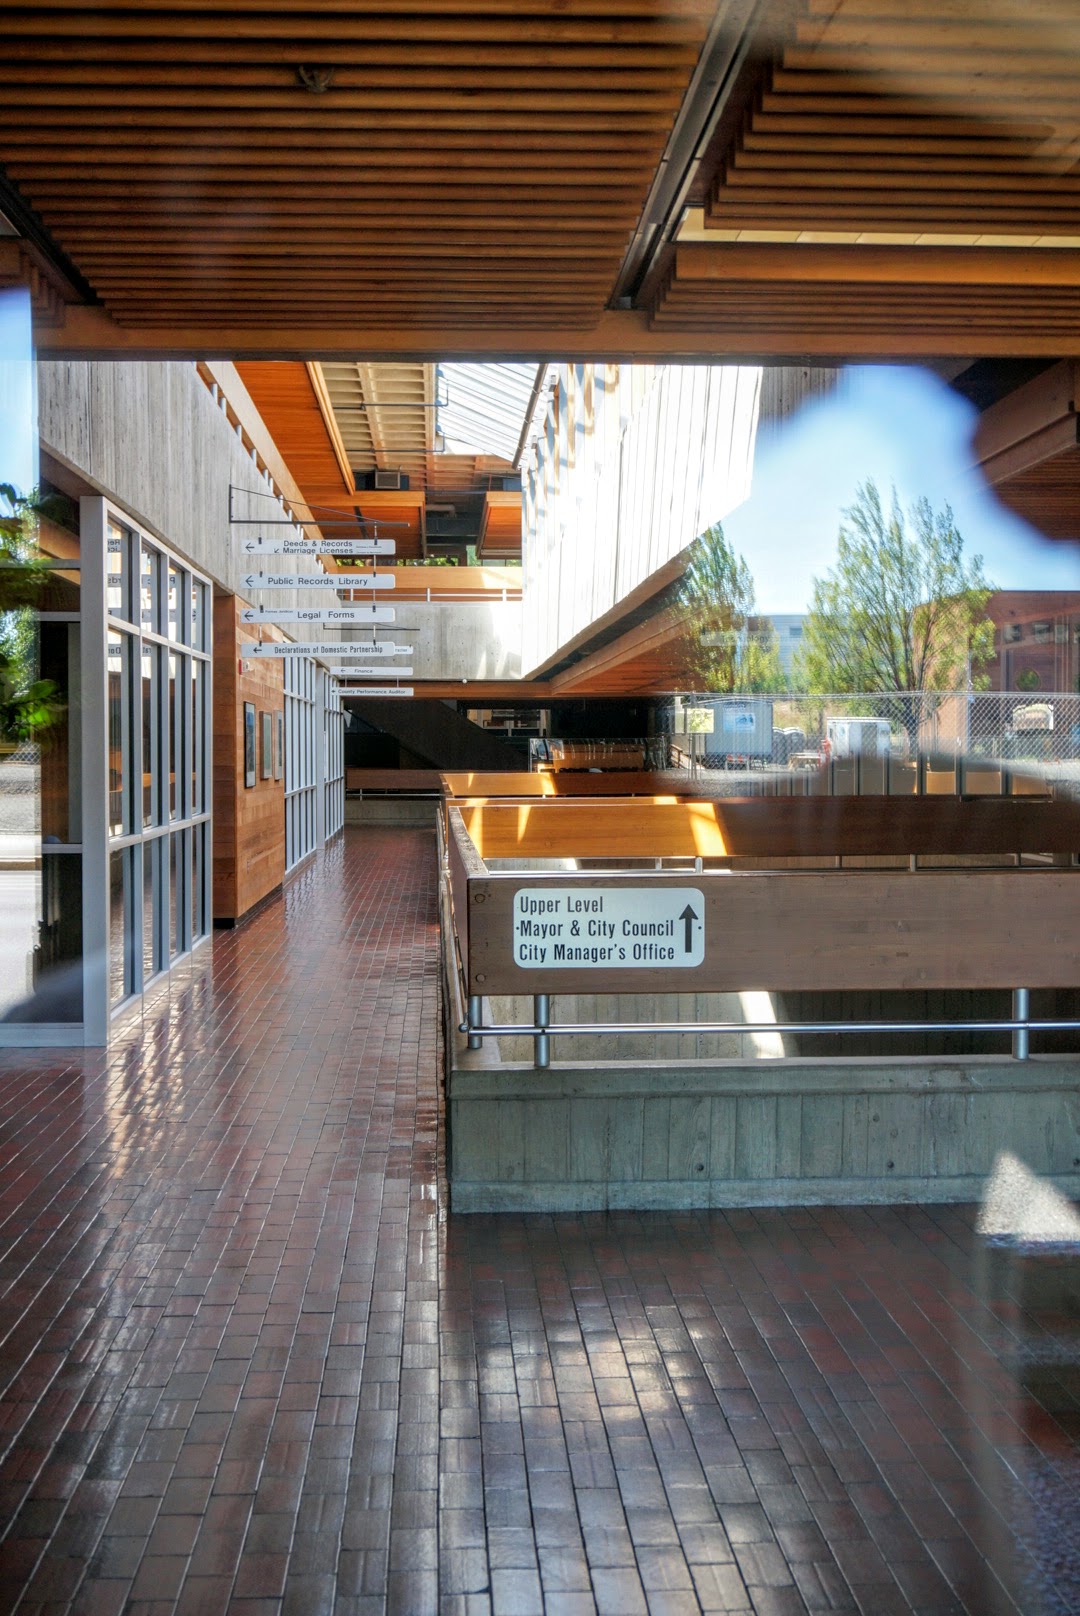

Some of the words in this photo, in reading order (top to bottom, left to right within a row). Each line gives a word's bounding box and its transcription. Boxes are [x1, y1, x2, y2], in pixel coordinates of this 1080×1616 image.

[339, 577, 368, 586] Library
[297, 611, 321, 620] Legal
[350, 645, 383, 653] Partnership
[520, 896, 561, 916] Upper
[567, 896, 604, 913] Level
[520, 920, 563, 939] Mayor
[570, 920, 580, 936] &
[588, 920, 615, 939] City
[622, 919, 674, 936] Council
[519, 944, 547, 963] City
[554, 944, 626, 963] Manager's
[633, 943, 675, 960] Office
